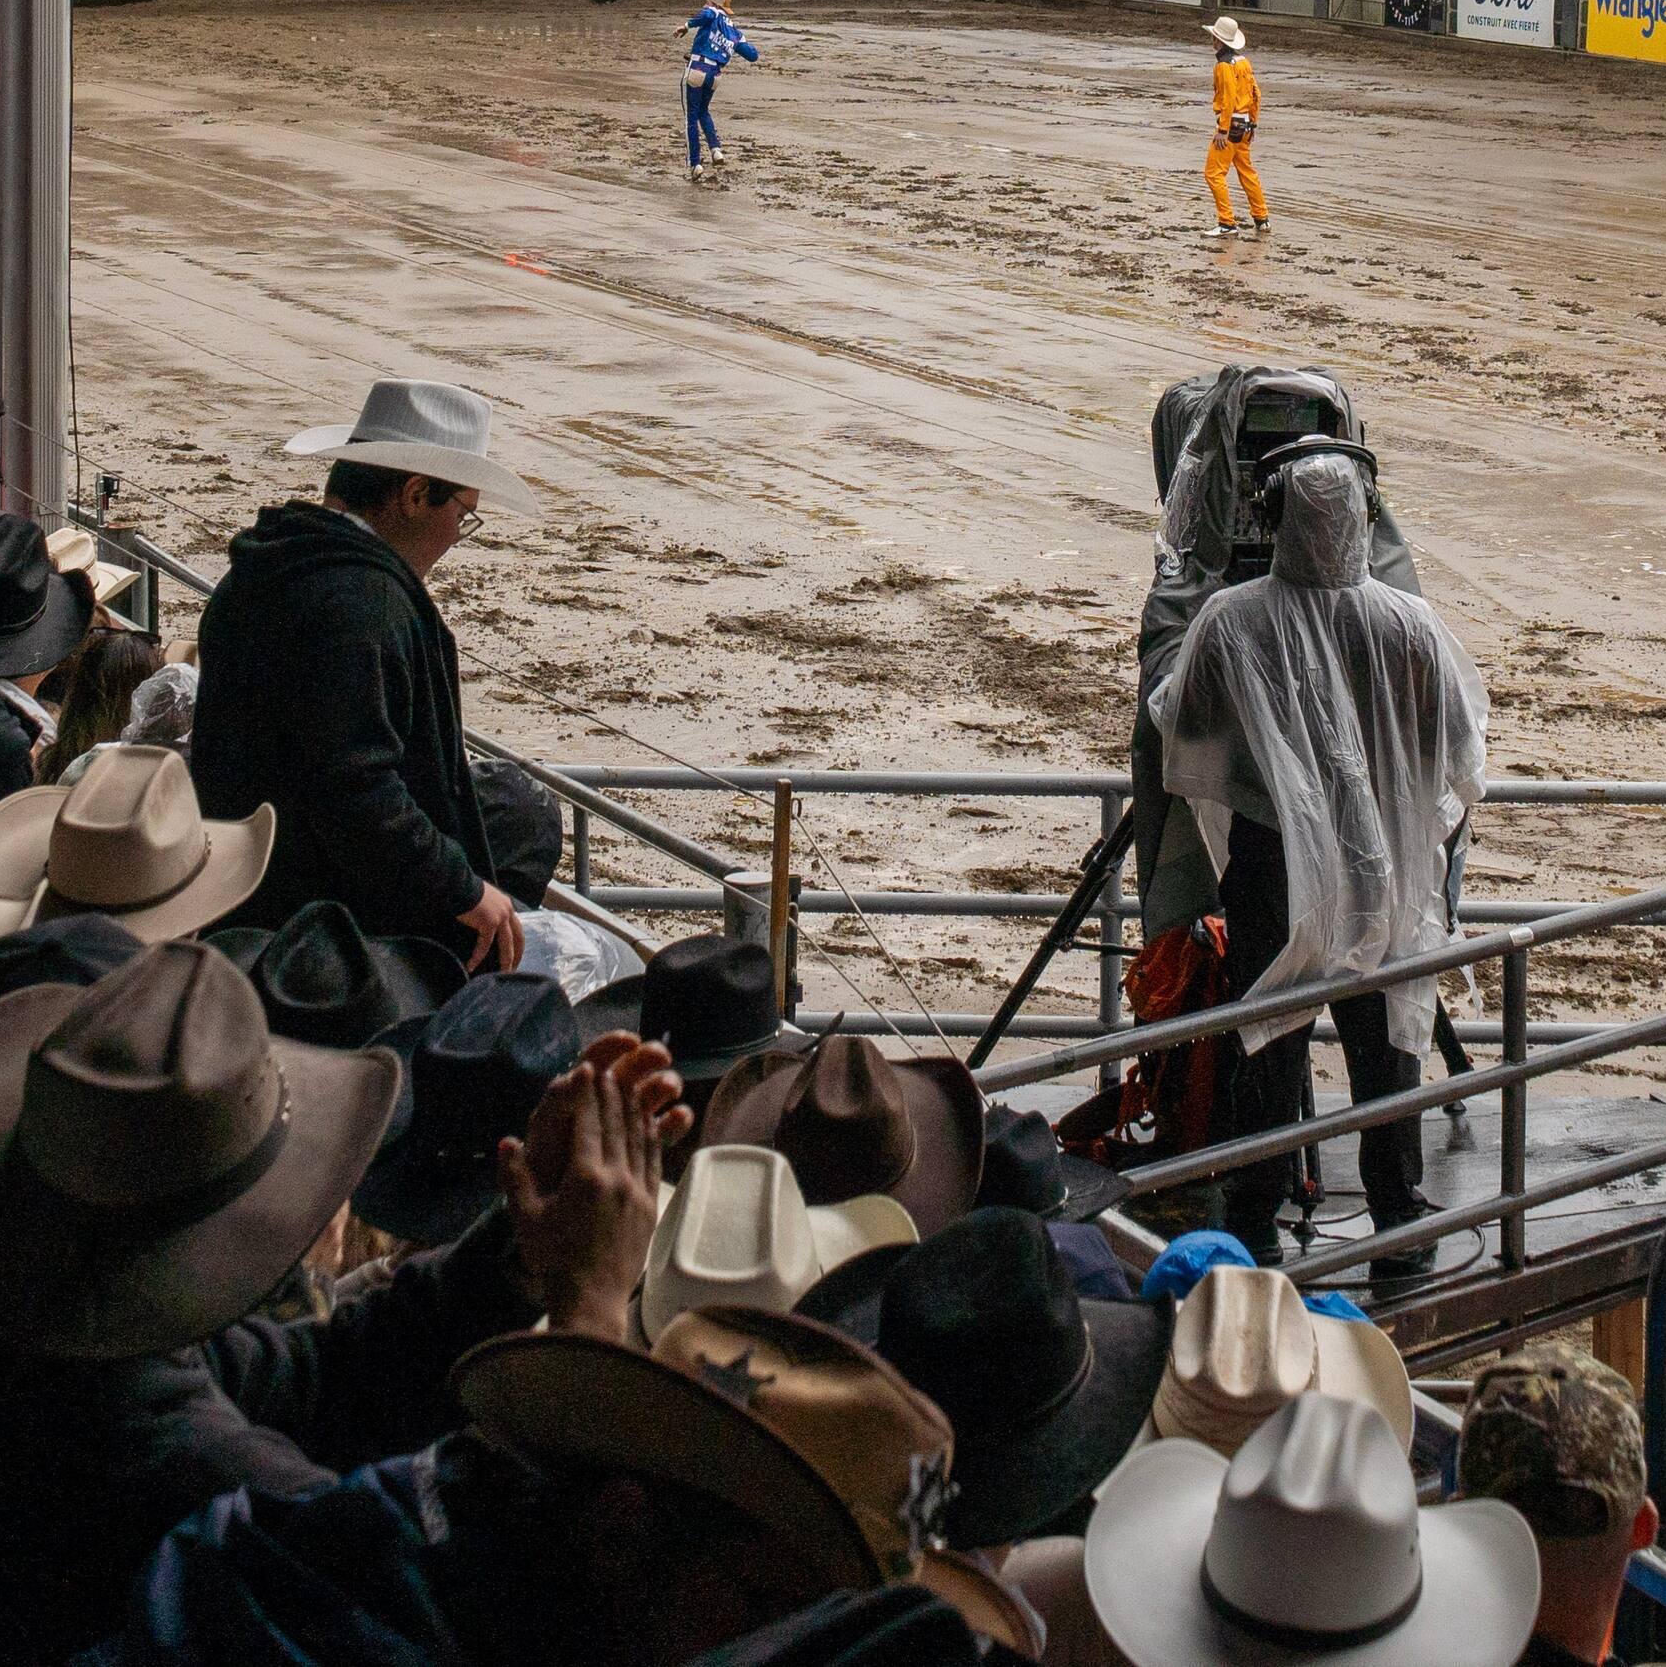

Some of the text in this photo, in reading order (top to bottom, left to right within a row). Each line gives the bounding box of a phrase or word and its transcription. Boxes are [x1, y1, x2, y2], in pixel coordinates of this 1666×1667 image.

[1467, 14, 1540, 33] CONSTRUIT AVEC FIERTÉ
